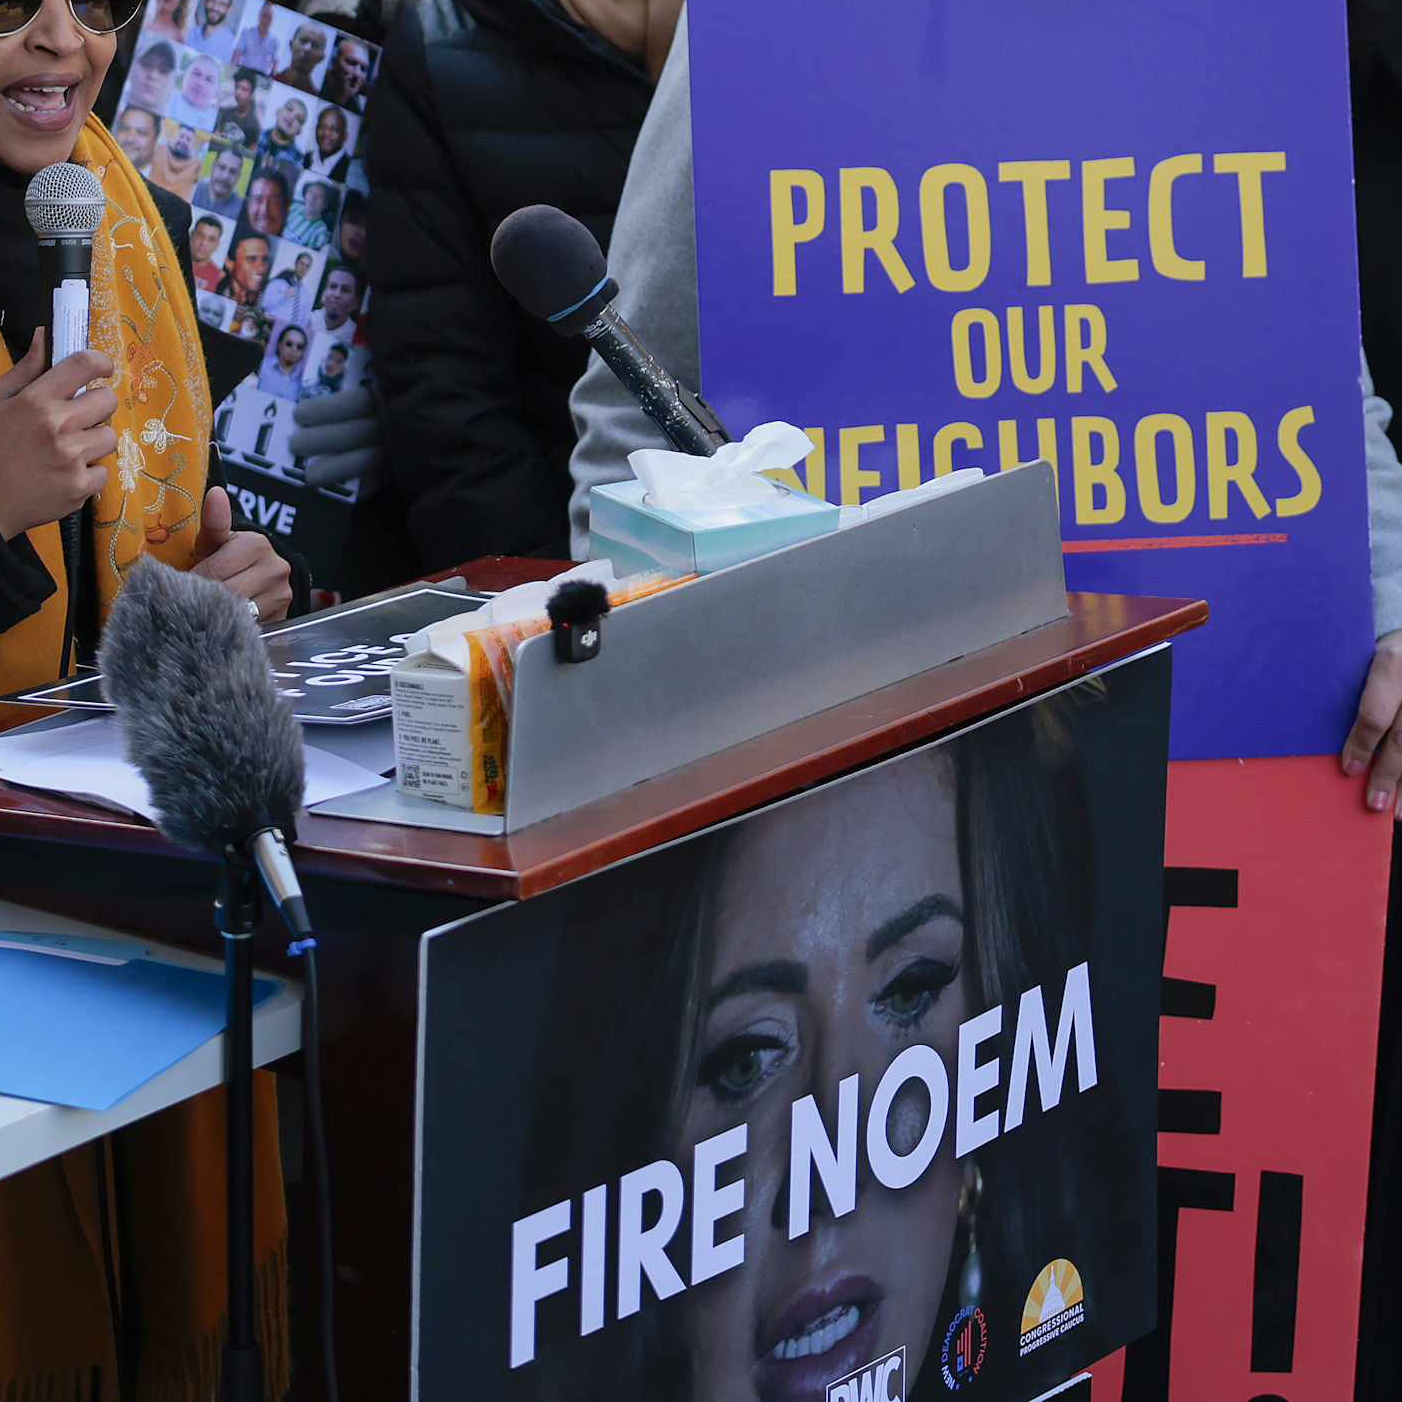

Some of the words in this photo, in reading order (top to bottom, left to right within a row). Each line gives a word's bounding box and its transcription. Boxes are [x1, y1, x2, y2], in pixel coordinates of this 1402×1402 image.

[768, 151, 1288, 298] PROTECT
[950, 304, 1118, 400] OUR
[286, 643, 404, 669] ICE
[509, 1123, 748, 1370] FIRE
[788, 960, 1098, 1242] NOEM
[941, 1304, 978, 1364] DEMOCRAT
[973, 1306, 991, 1375] COALITION
[1019, 1303, 1085, 1347] CONGRESSIONAL
[1019, 1326, 1060, 1358] PROGRESSIVE
[1060, 1314, 1085, 1337] CAUCUS
[941, 1365, 957, 1391] NEW
